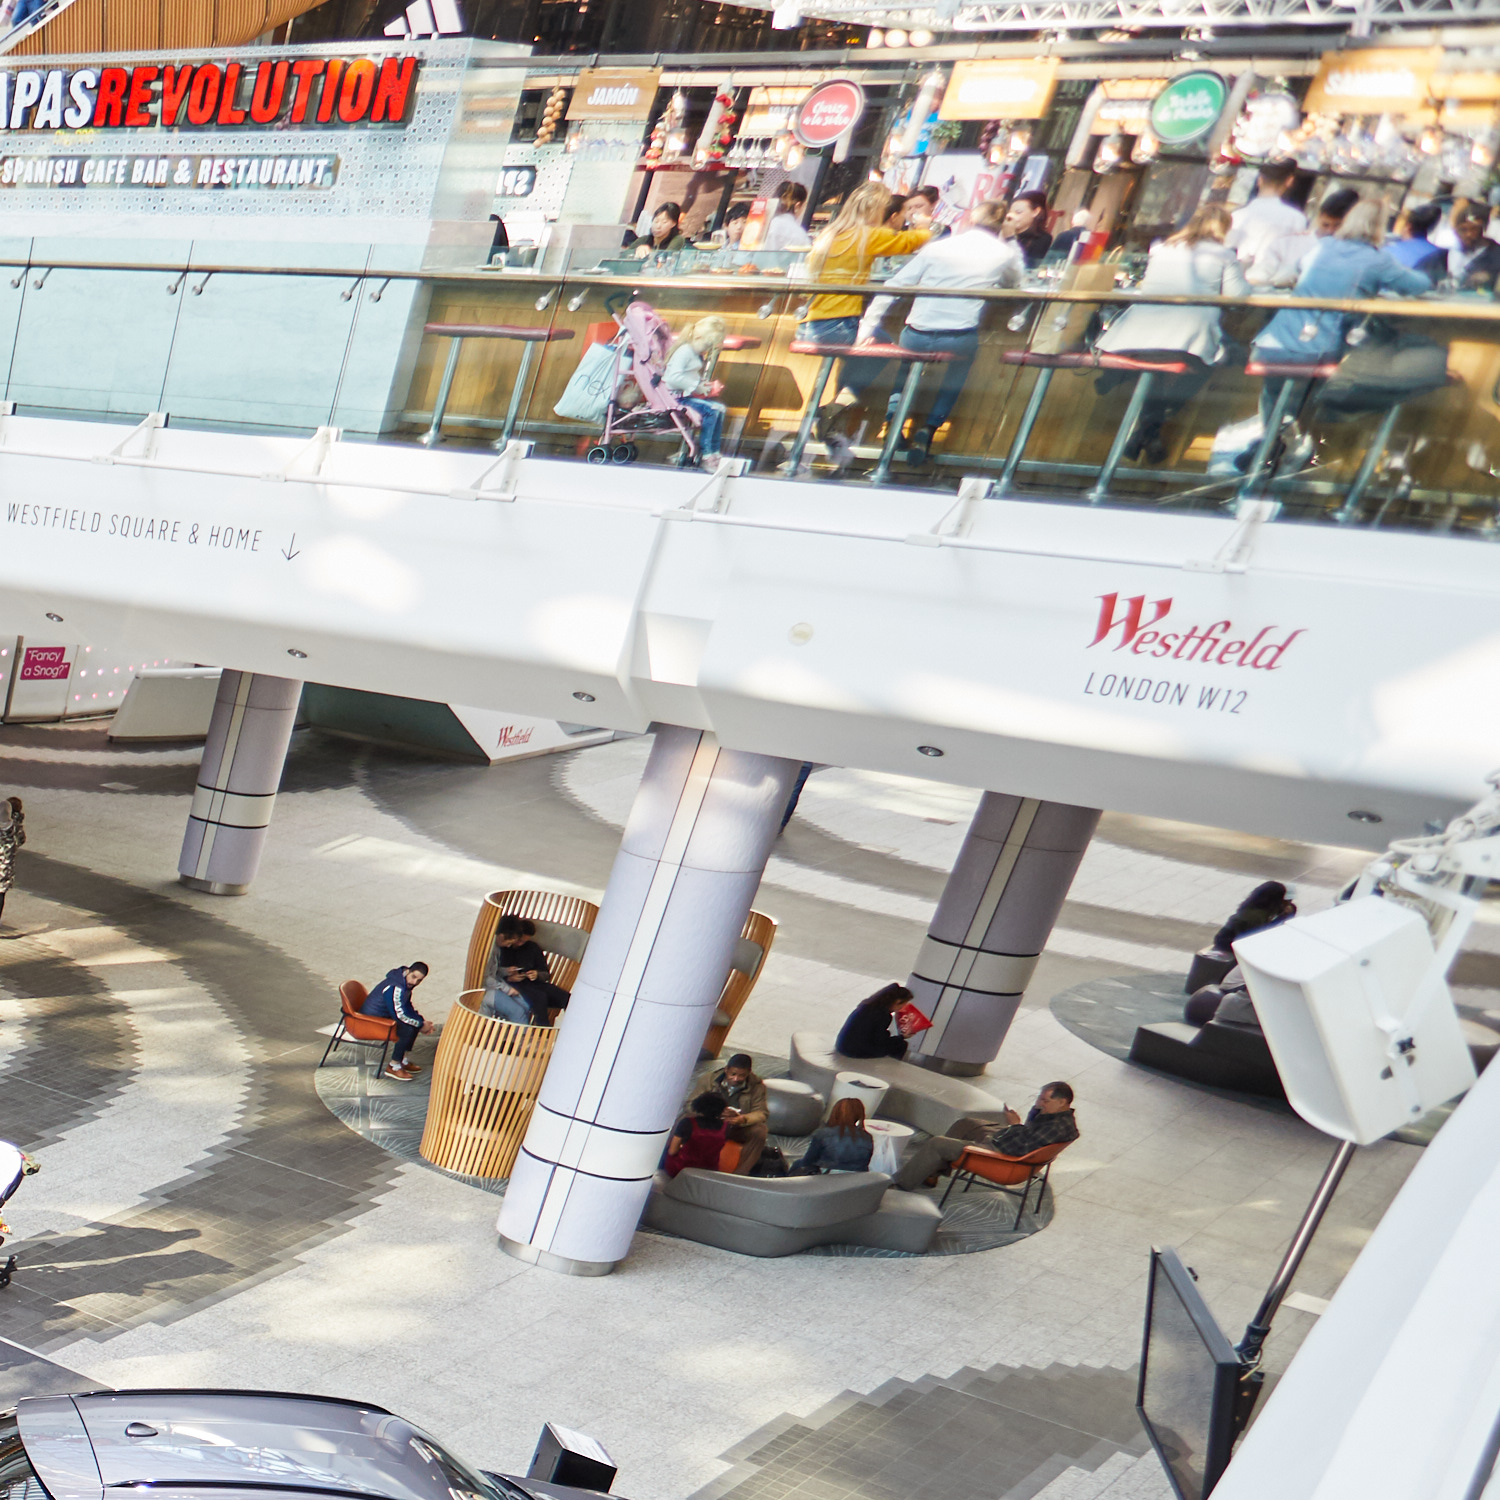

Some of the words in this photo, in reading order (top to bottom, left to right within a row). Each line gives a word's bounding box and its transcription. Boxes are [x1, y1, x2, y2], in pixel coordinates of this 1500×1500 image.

[587, 83, 639, 106] JAMÓN
[1, 158, 78, 185] SPANISH
[81, 158, 126, 185] CAFE
[131, 158, 168, 185] BAR
[173, 158, 191, 185] &
[196, 158, 328, 185] RESTAURANT
[7, 502, 102, 533] WESTFIELD
[109, 513, 181, 543] SQUARE
[188, 523, 199, 545] &
[208, 525, 262, 552] HOME
[1085, 591, 1309, 671] Westfield
[23, 667, 31, 676] a
[1084, 671, 1189, 707] LONDON
[1197, 686, 1248, 714] W12
